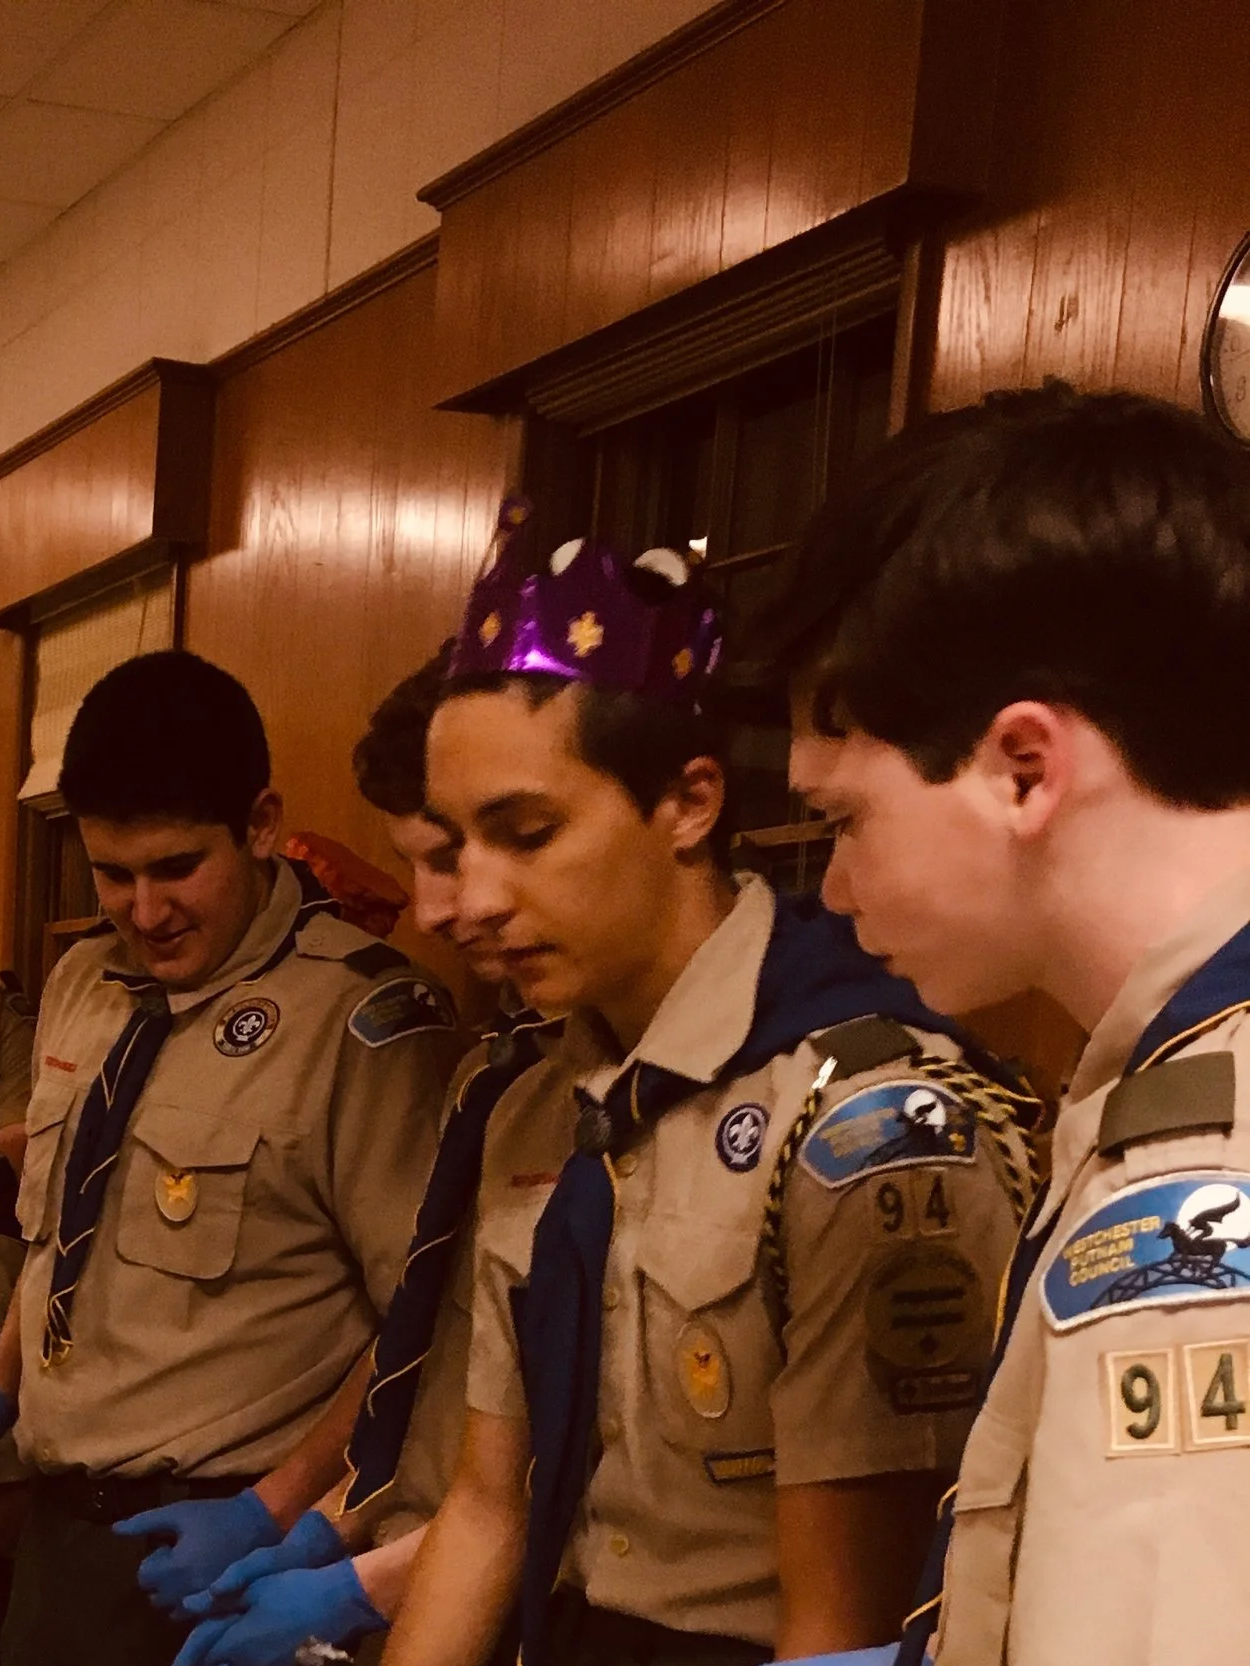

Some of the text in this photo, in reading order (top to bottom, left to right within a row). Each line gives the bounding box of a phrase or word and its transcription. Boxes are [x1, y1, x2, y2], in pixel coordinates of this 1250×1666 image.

[877, 1173, 950, 1233] 94
[1069, 1255, 1135, 1287] COUNCIL
[1120, 1353, 1246, 1440] 94
